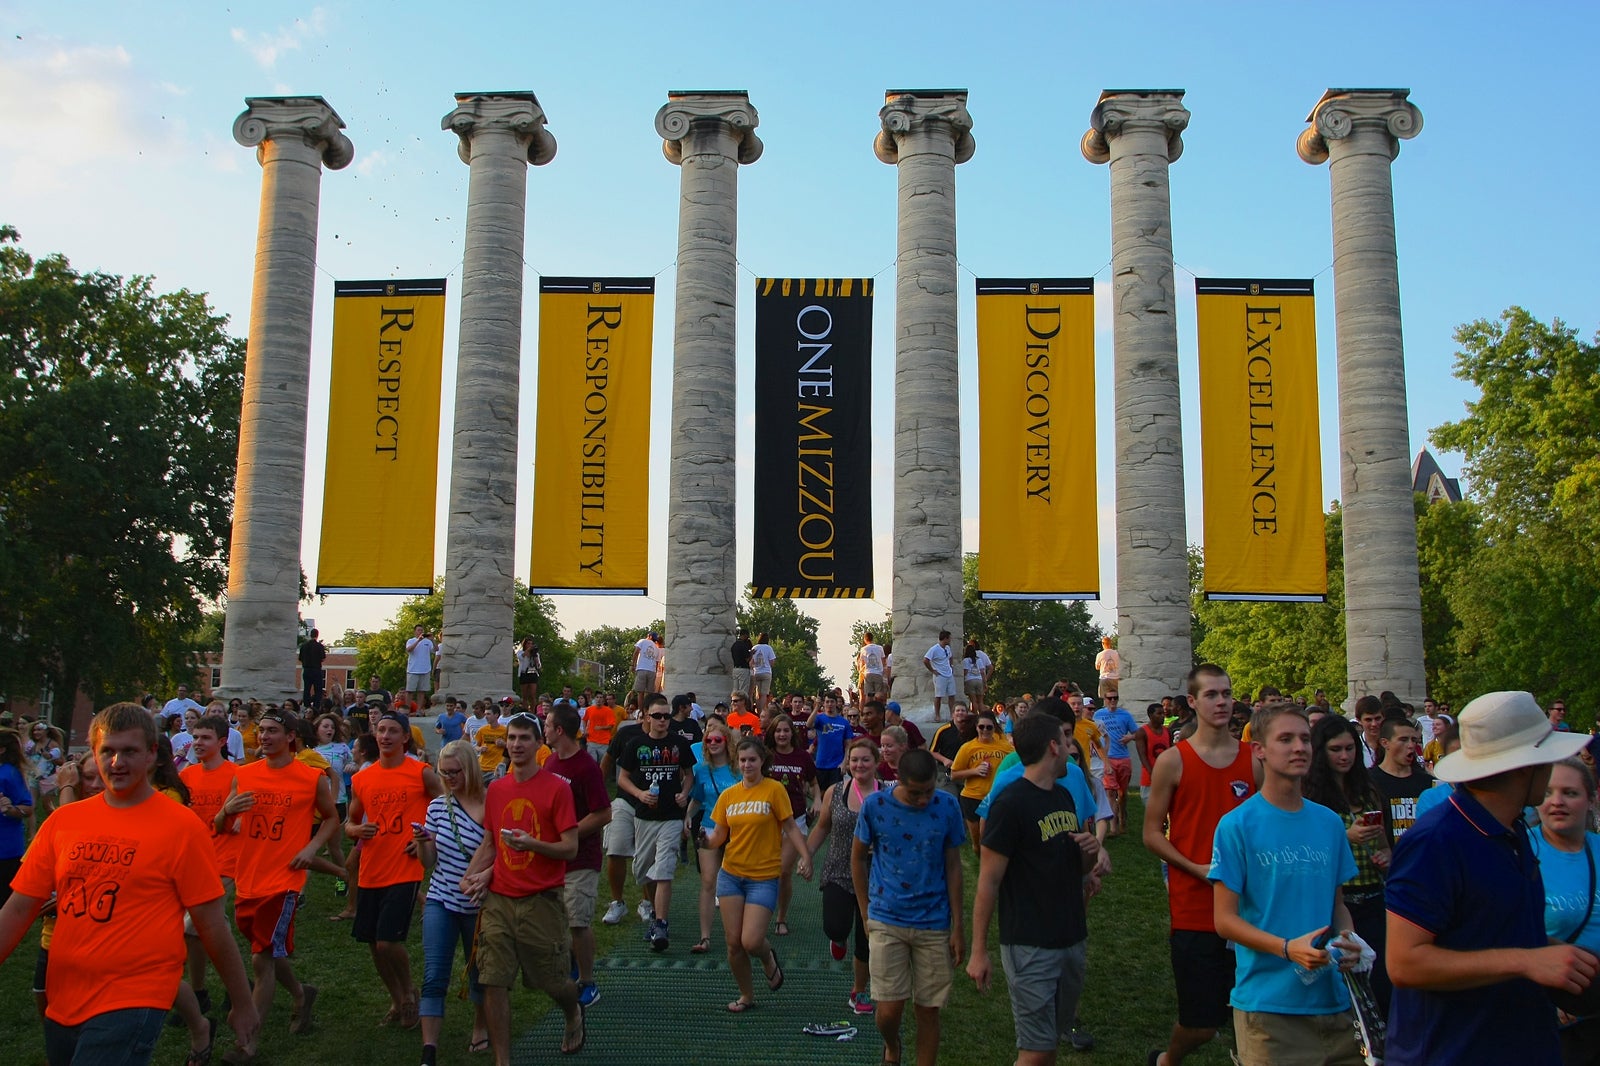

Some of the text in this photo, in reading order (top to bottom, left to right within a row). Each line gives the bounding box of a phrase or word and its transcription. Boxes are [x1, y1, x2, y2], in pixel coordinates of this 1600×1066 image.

[375, 304, 415, 461] RESPECT
[1025, 304, 1061, 504] DISCOVERY
[1246, 303, 1282, 536] EXCELLENCE
[580, 302, 622, 578] RESPONSIBILITY
[645, 772, 673, 780] SAFE
[249, 815, 285, 841] AG
[1038, 811, 1079, 841] MIZZO
[69, 842, 136, 866] SWAG
[1256, 850, 1280, 867] We
[62, 876, 120, 923] AG
